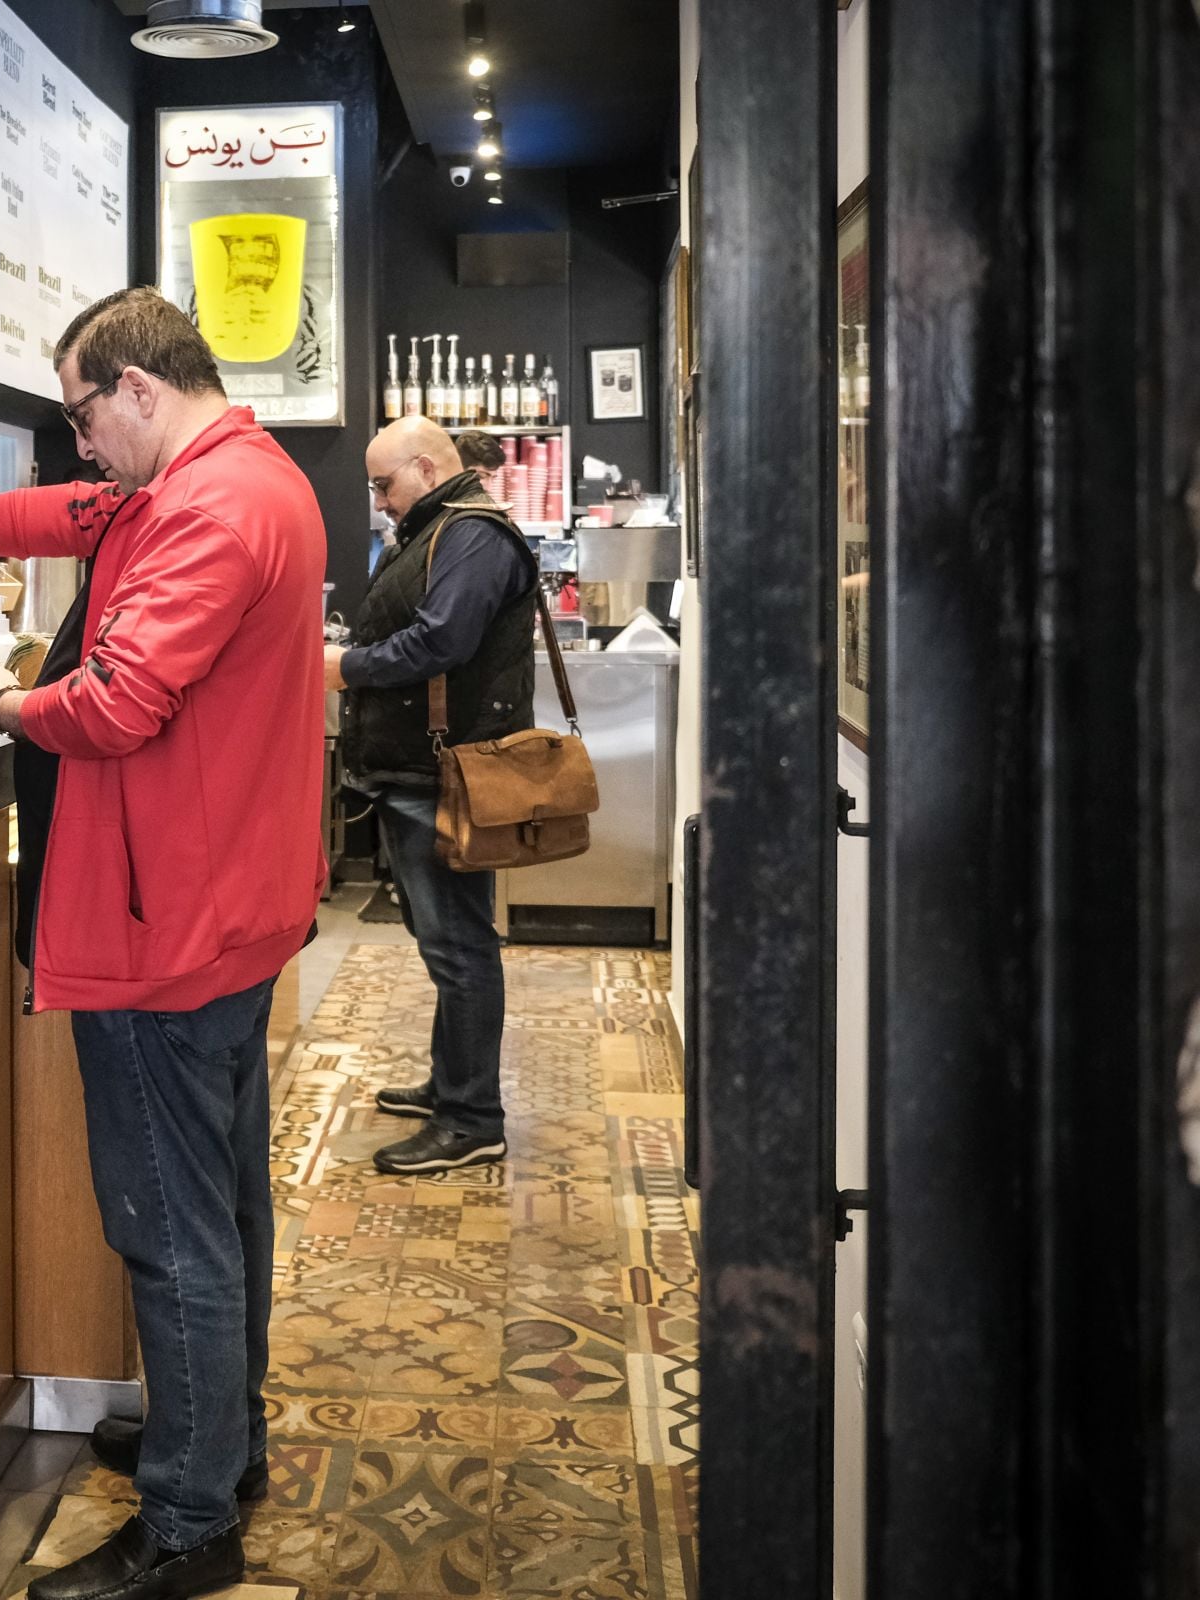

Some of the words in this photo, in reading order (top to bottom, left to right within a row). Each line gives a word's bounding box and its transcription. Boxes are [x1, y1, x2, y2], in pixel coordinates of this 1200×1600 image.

[0, 252, 26, 282] Brazil
[39, 266, 61, 292] Brazil
[0, 314, 26, 342] Bolivia
